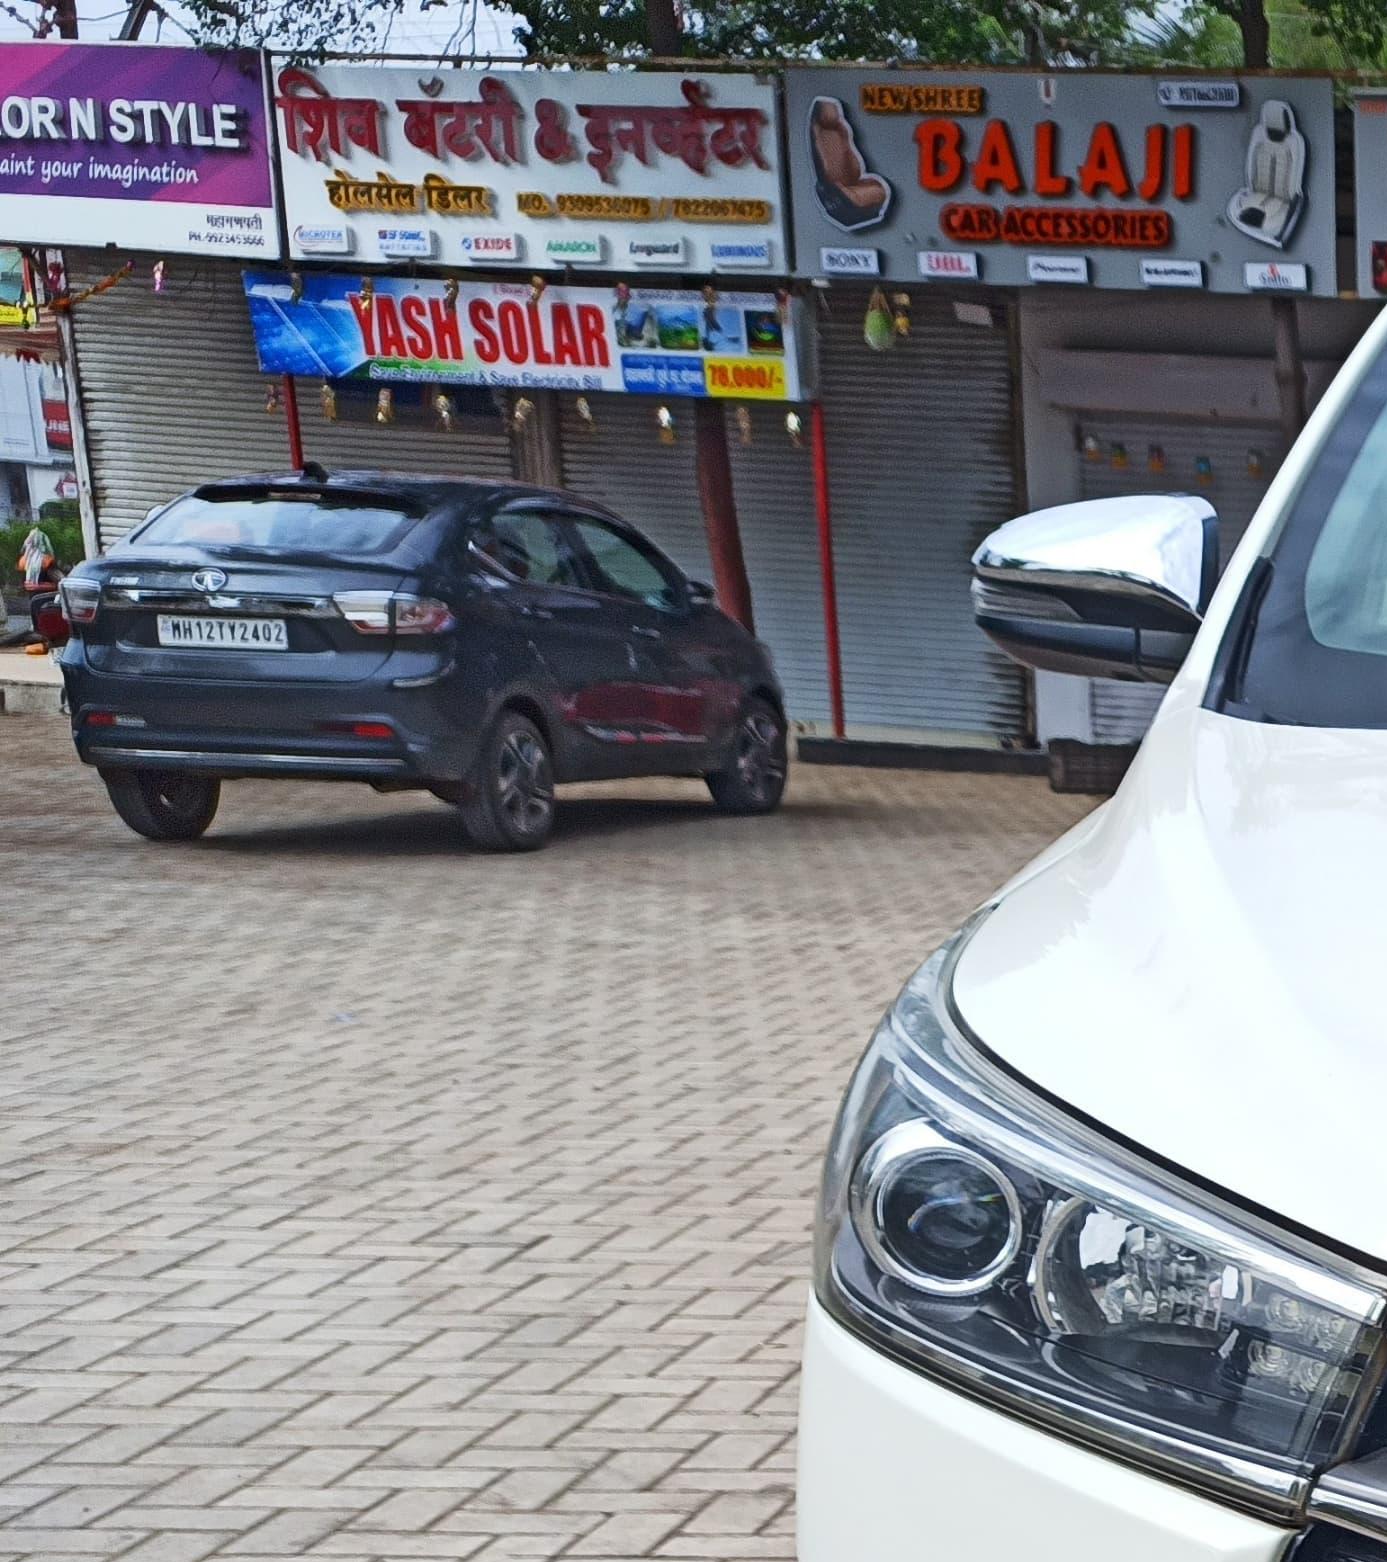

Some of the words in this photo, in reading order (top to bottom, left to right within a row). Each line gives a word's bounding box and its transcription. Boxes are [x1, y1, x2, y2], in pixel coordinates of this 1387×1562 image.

[276, 68, 381, 162] शिव
[395, 76, 521, 163] बॅटरी
[534, 98, 570, 161] &
[862, 87, 903, 110] NEW
[908, 88, 981, 112] SHREE
[0, 97, 58, 140] OR
[69, 97, 96, 140] N
[108, 99, 241, 149] STYLE
[41, 160, 82, 184] your
[88, 156, 199, 189] imagination
[914, 119, 1194, 201] BALAJI
[325, 169, 417, 213] होलसेल
[422, 172, 491, 215] डिलर
[474, 237, 513, 251] EXIDE
[943, 206, 996, 236] CAR
[1004, 207, 1168, 243] ACCESSORIES
[348, 292, 464, 361] YASH
[468, 297, 611, 367] SOLAR
[172, 616, 285, 643] MH12TY2402
